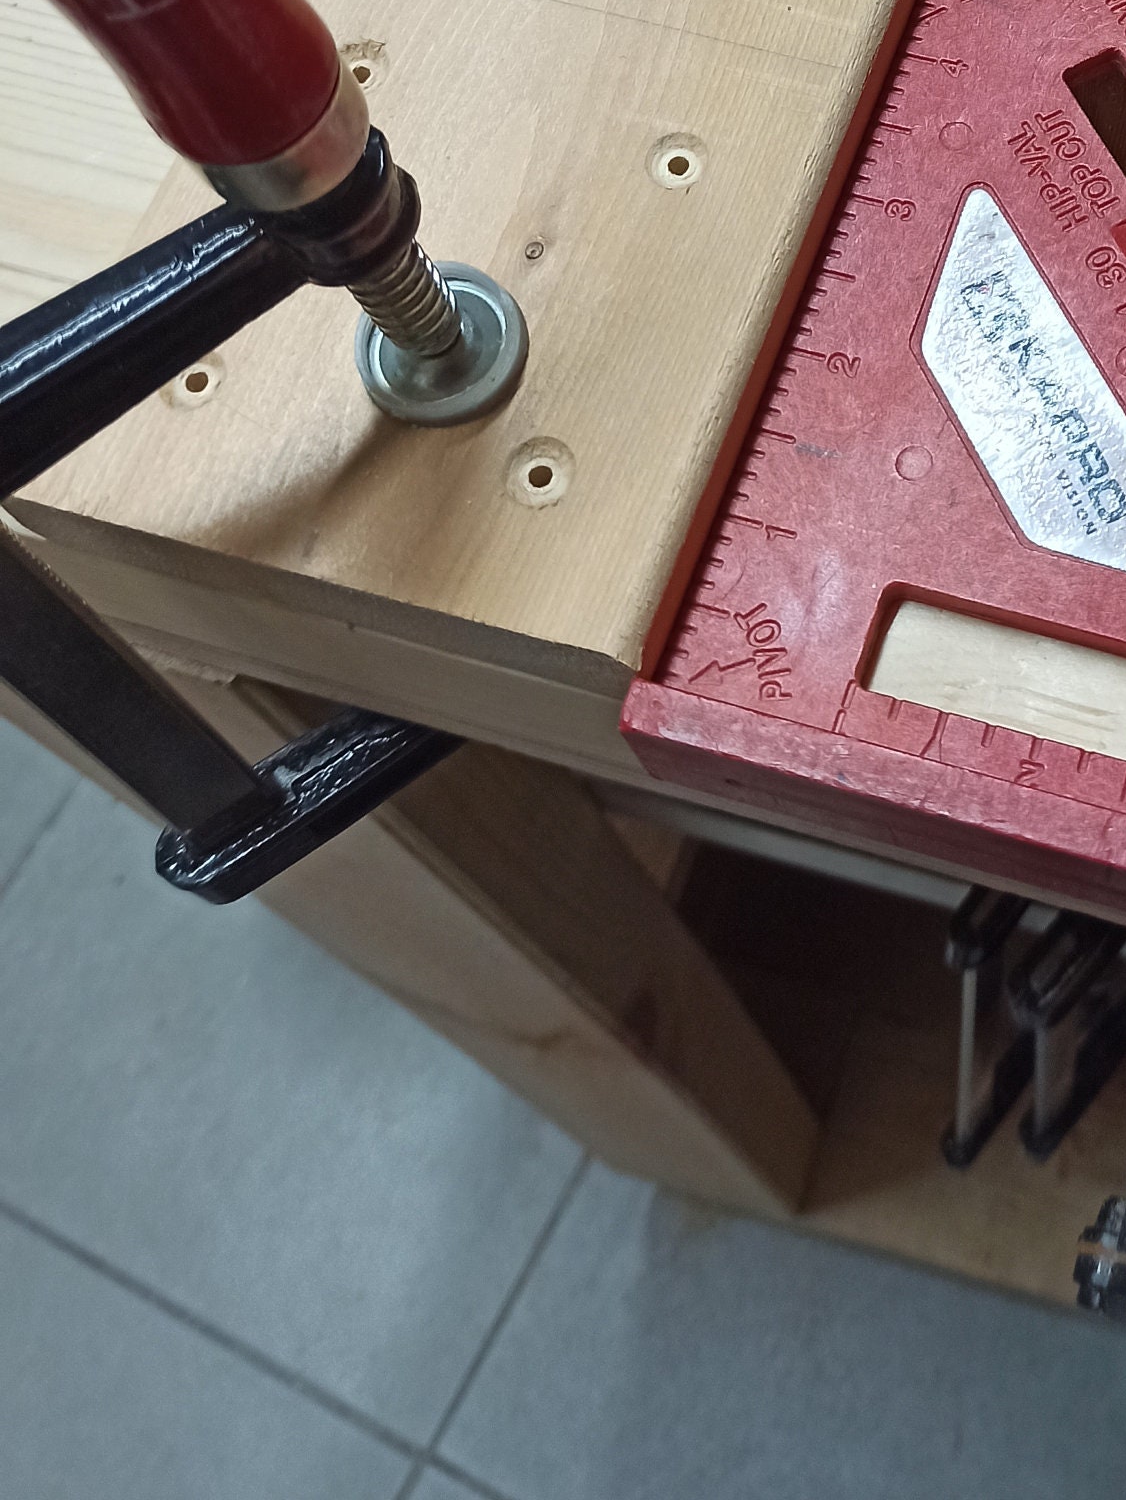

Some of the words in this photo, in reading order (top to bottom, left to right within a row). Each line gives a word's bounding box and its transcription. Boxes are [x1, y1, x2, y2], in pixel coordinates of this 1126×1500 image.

[939, 58, 970, 78] 4
[1034, 109, 1087, 161] CUT
[1007, 120, 1089, 232] HIP-VAL
[1071, 164, 1120, 220] TOP
[884, 198, 917, 221] 3
[826, 351, 862, 378] 2
[765, 524, 798, 541] 1
[733, 602, 793, 701] PIVOT
